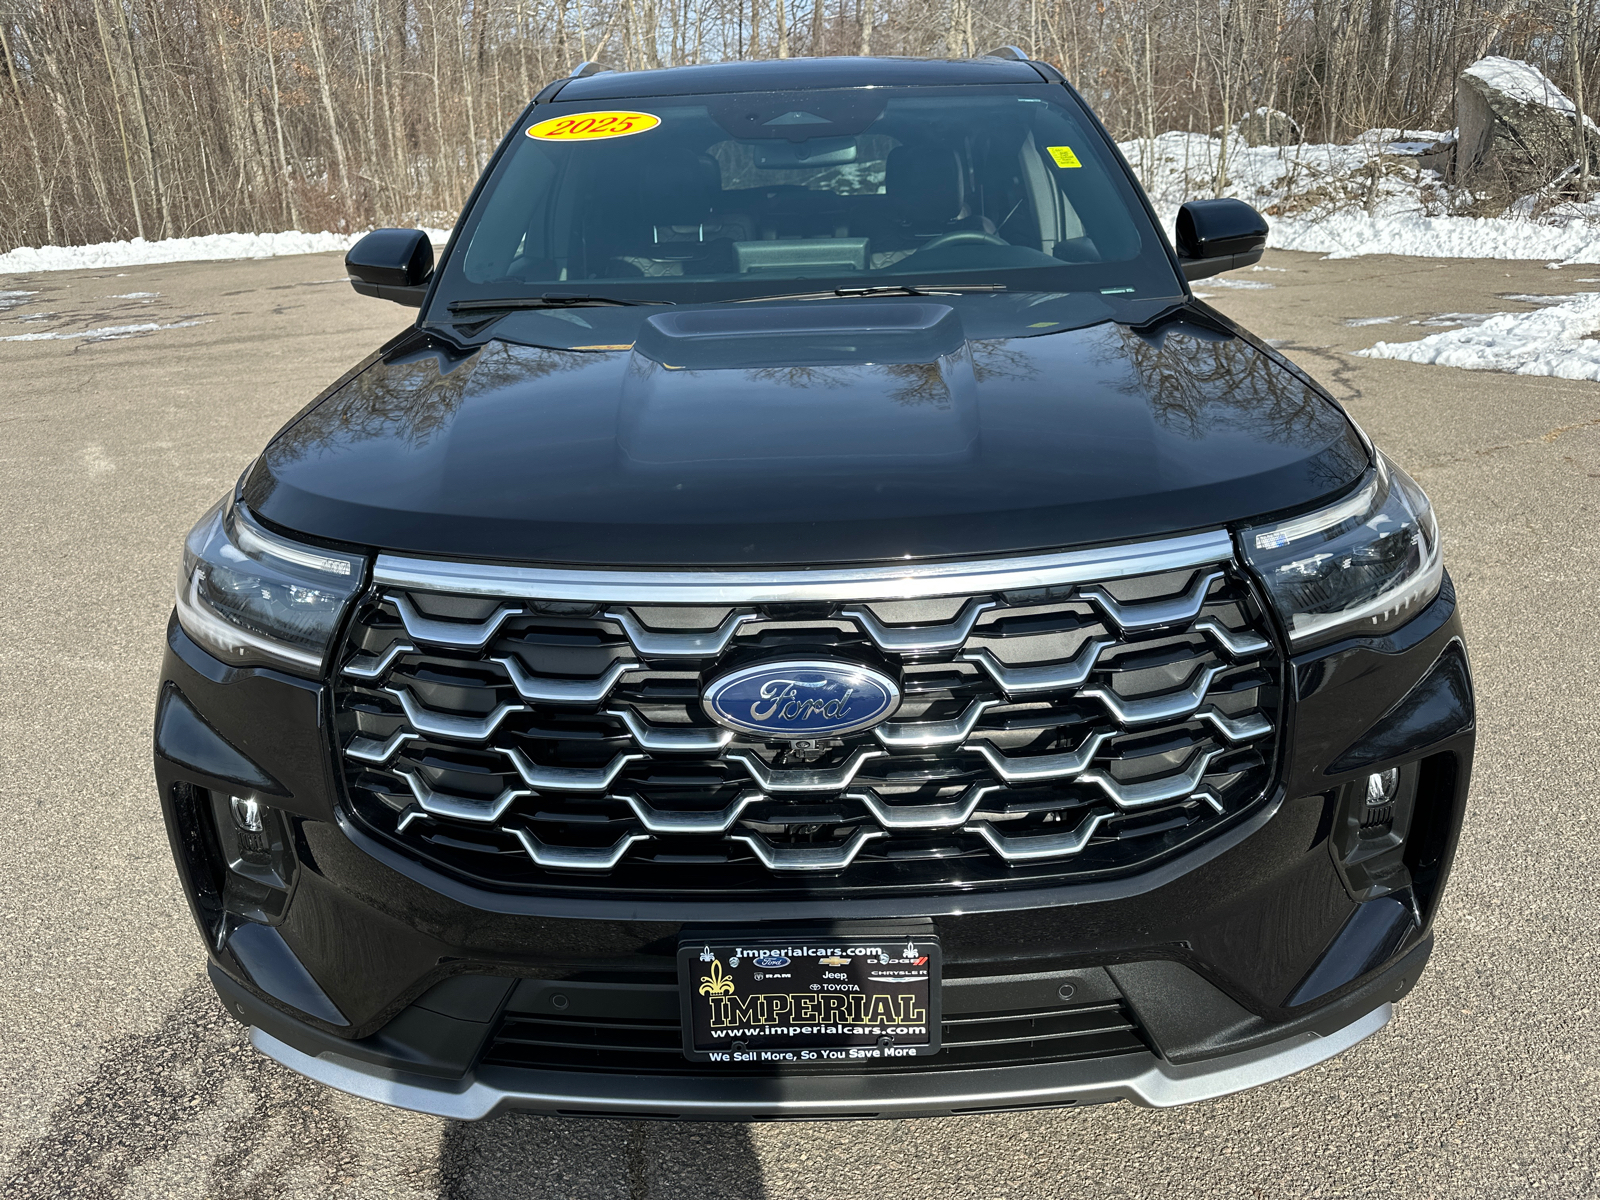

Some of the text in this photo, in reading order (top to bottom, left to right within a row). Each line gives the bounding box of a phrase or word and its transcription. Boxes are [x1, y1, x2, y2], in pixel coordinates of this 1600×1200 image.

[545, 116, 641, 136] 2025
[750, 678, 853, 721] Ford
[735, 946, 882, 960] Imperialcars.com
[822, 971, 847, 980] Jeep
[822, 983, 861, 992] TOYOTA
[709, 993, 926, 1028] IMPERIAL
[711, 1024, 926, 1038] www.imperialcars.com
[709, 1047, 917, 1062] We Sell More, So You Save More
